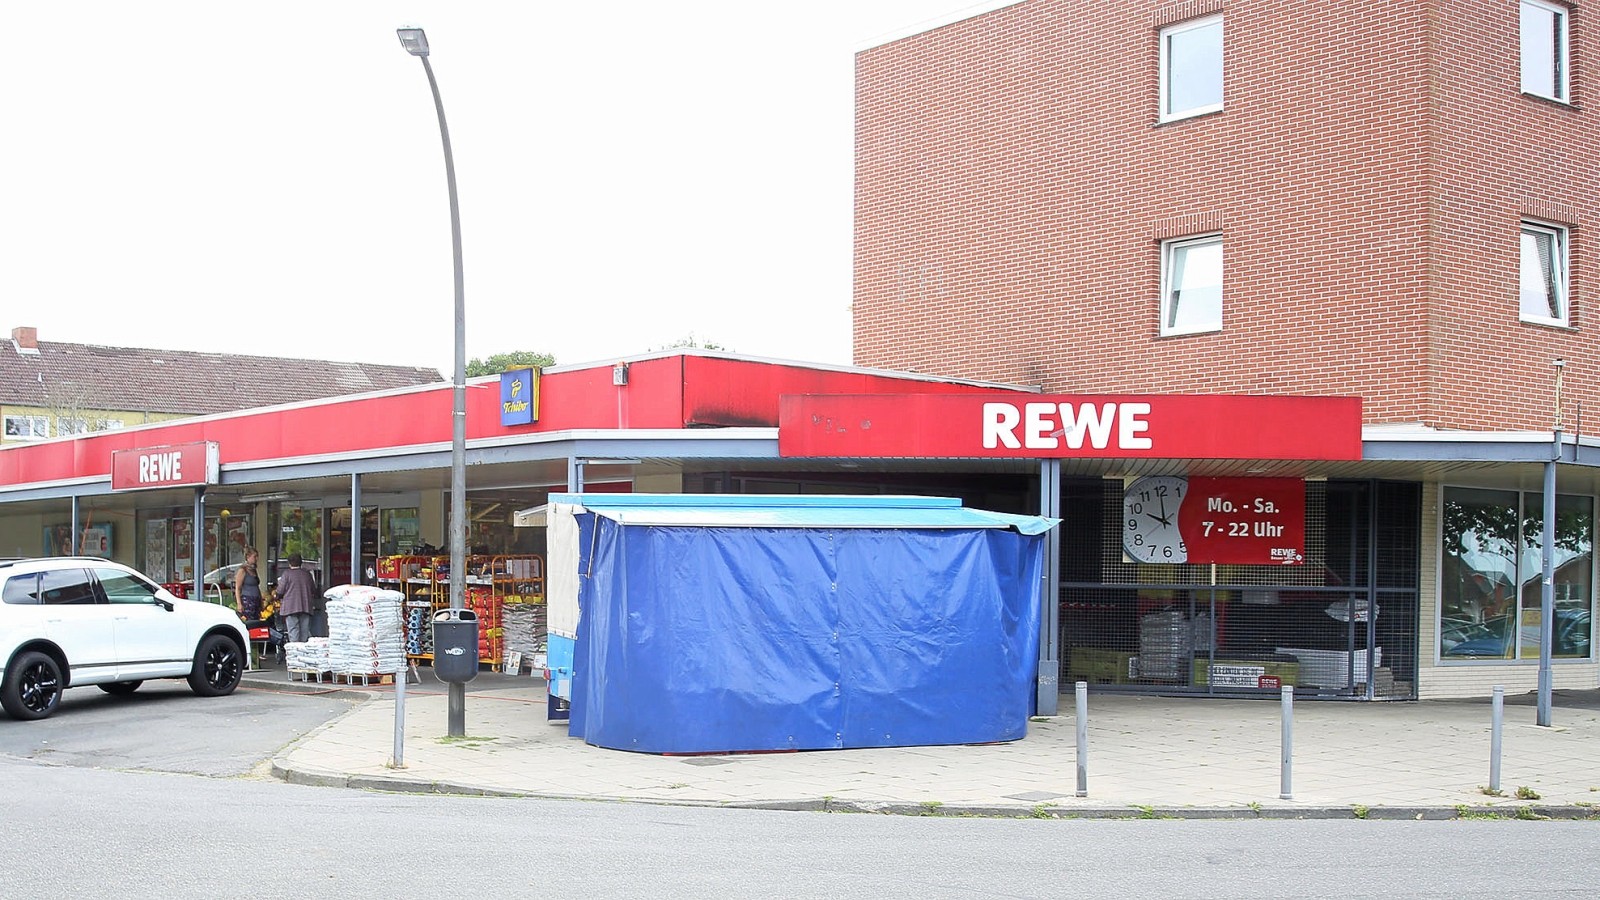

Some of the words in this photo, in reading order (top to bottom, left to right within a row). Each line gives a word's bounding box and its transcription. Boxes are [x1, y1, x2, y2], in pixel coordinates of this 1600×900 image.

[503, 401, 528, 413] Tchibo
[982, 402, 1152, 449] REWE
[139, 452, 182, 483] REWE
[1139, 491, 1150, 502] 11
[1154, 485, 1168, 497] 12
[1175, 487, 1181, 498] 1
[1129, 502, 1143, 514] 10
[1207, 497, 1238, 513] Mo.
[1254, 497, 1280, 513] Sa.
[1128, 519, 1138, 530] 9
[1202, 521, 1214, 537] 7
[1228, 522, 1249, 537] 22
[1254, 521, 1284, 537] Uhr
[1134, 533, 1144, 546] 8
[1148, 544, 1157, 557] 7
[1163, 545, 1173, 558] 6
[1270, 548, 1297, 556] REWE
